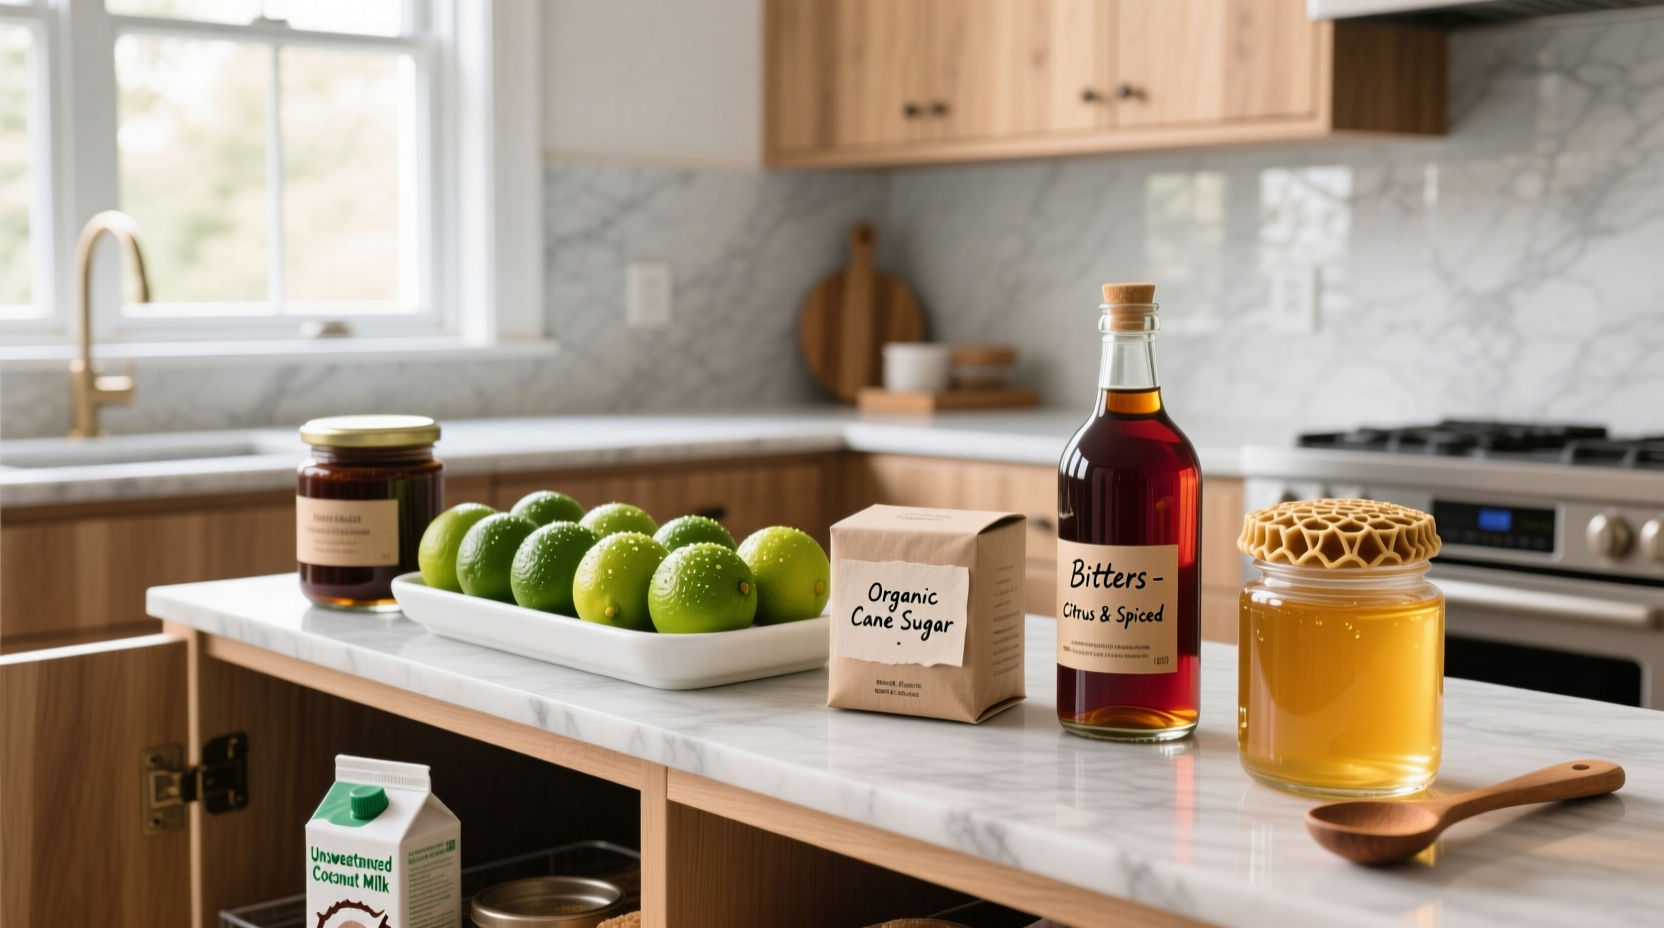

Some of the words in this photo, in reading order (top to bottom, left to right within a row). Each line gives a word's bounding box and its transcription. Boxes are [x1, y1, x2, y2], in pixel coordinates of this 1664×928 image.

[1070, 558, 1147, 590] Bitters
[868, 581, 939, 613] Organic
[850, 605, 894, 629] Cane
[900, 609, 954, 641] Sugar
[1063, 601, 1095, 621] Citrus
[1100, 605, 1111, 623] &
[1116, 603, 1165, 630] Spiced
[363, 873, 390, 894] Milk
